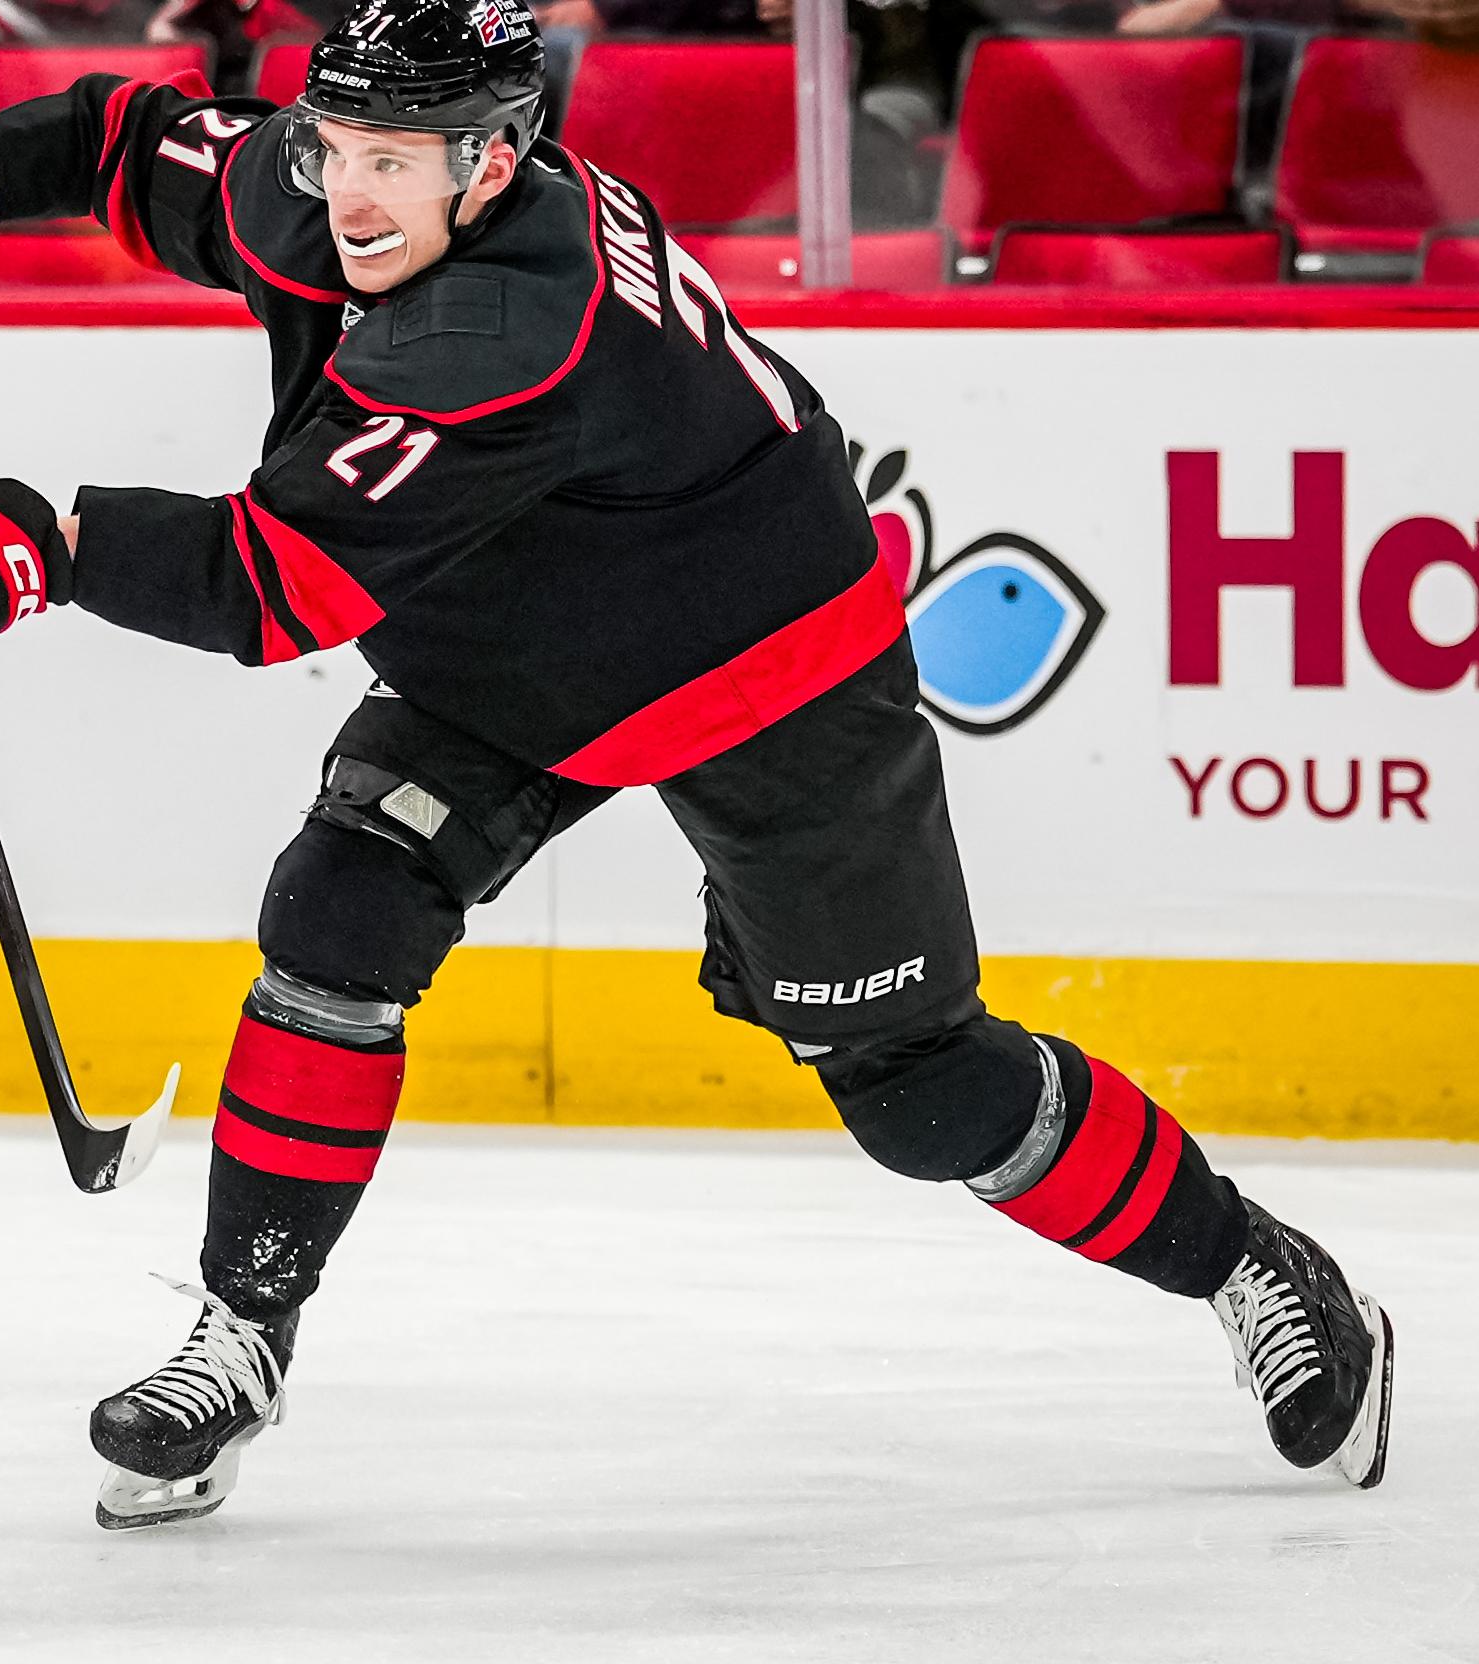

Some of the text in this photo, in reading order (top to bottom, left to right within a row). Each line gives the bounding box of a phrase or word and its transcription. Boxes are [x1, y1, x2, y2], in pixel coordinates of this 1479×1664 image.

[348, 8, 396, 42] 21
[318, 68, 371, 90] BAUER
[156, 107, 253, 177] 21
[324, 415, 442, 503] 21
[1169, 756, 1431, 822] YOUR
[773, 955, 926, 1005] BAUER
